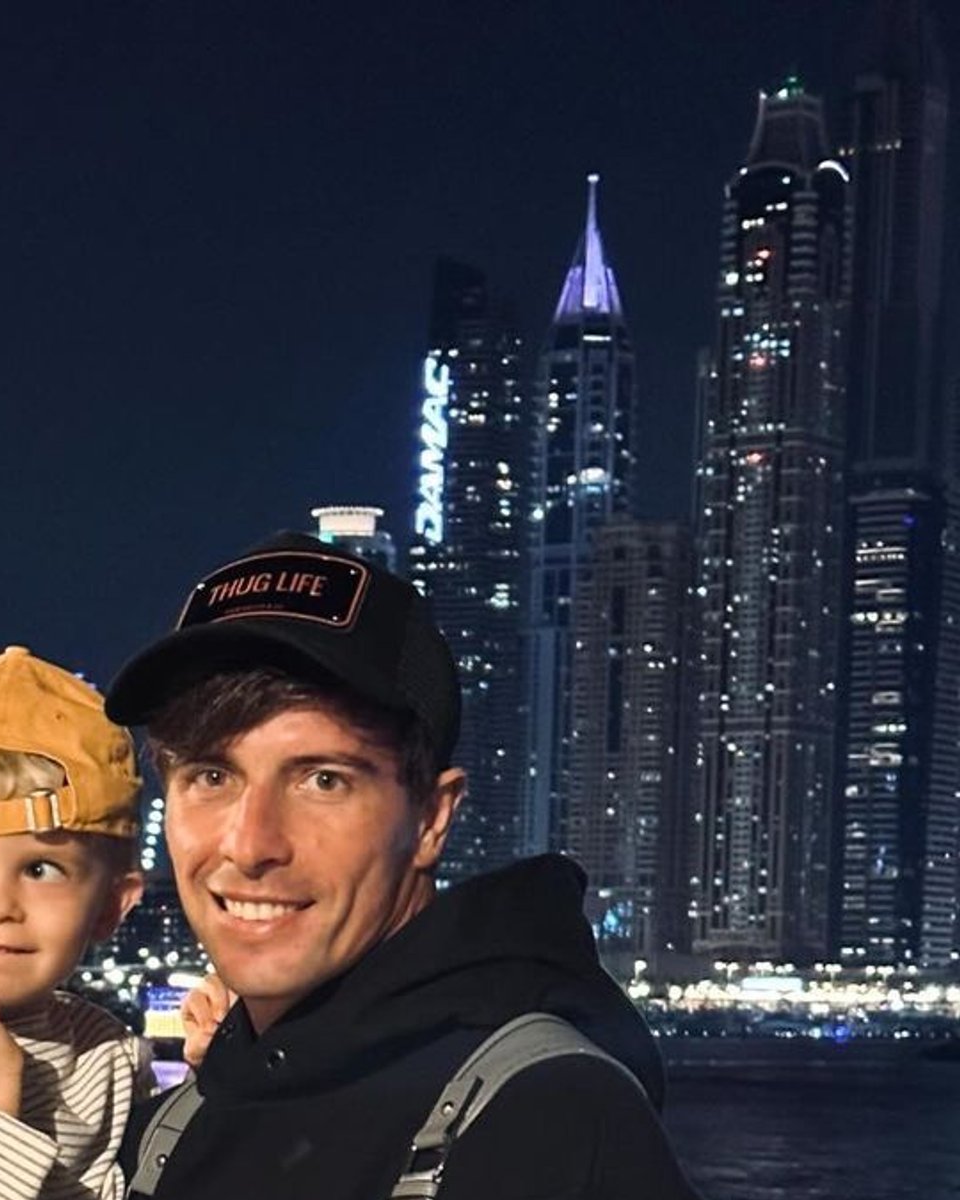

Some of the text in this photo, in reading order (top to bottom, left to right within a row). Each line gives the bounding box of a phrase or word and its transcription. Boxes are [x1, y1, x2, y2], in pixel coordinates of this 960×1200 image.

[415, 356, 449, 543] DAMAC
[207, 571, 328, 606] THUG LIFE
